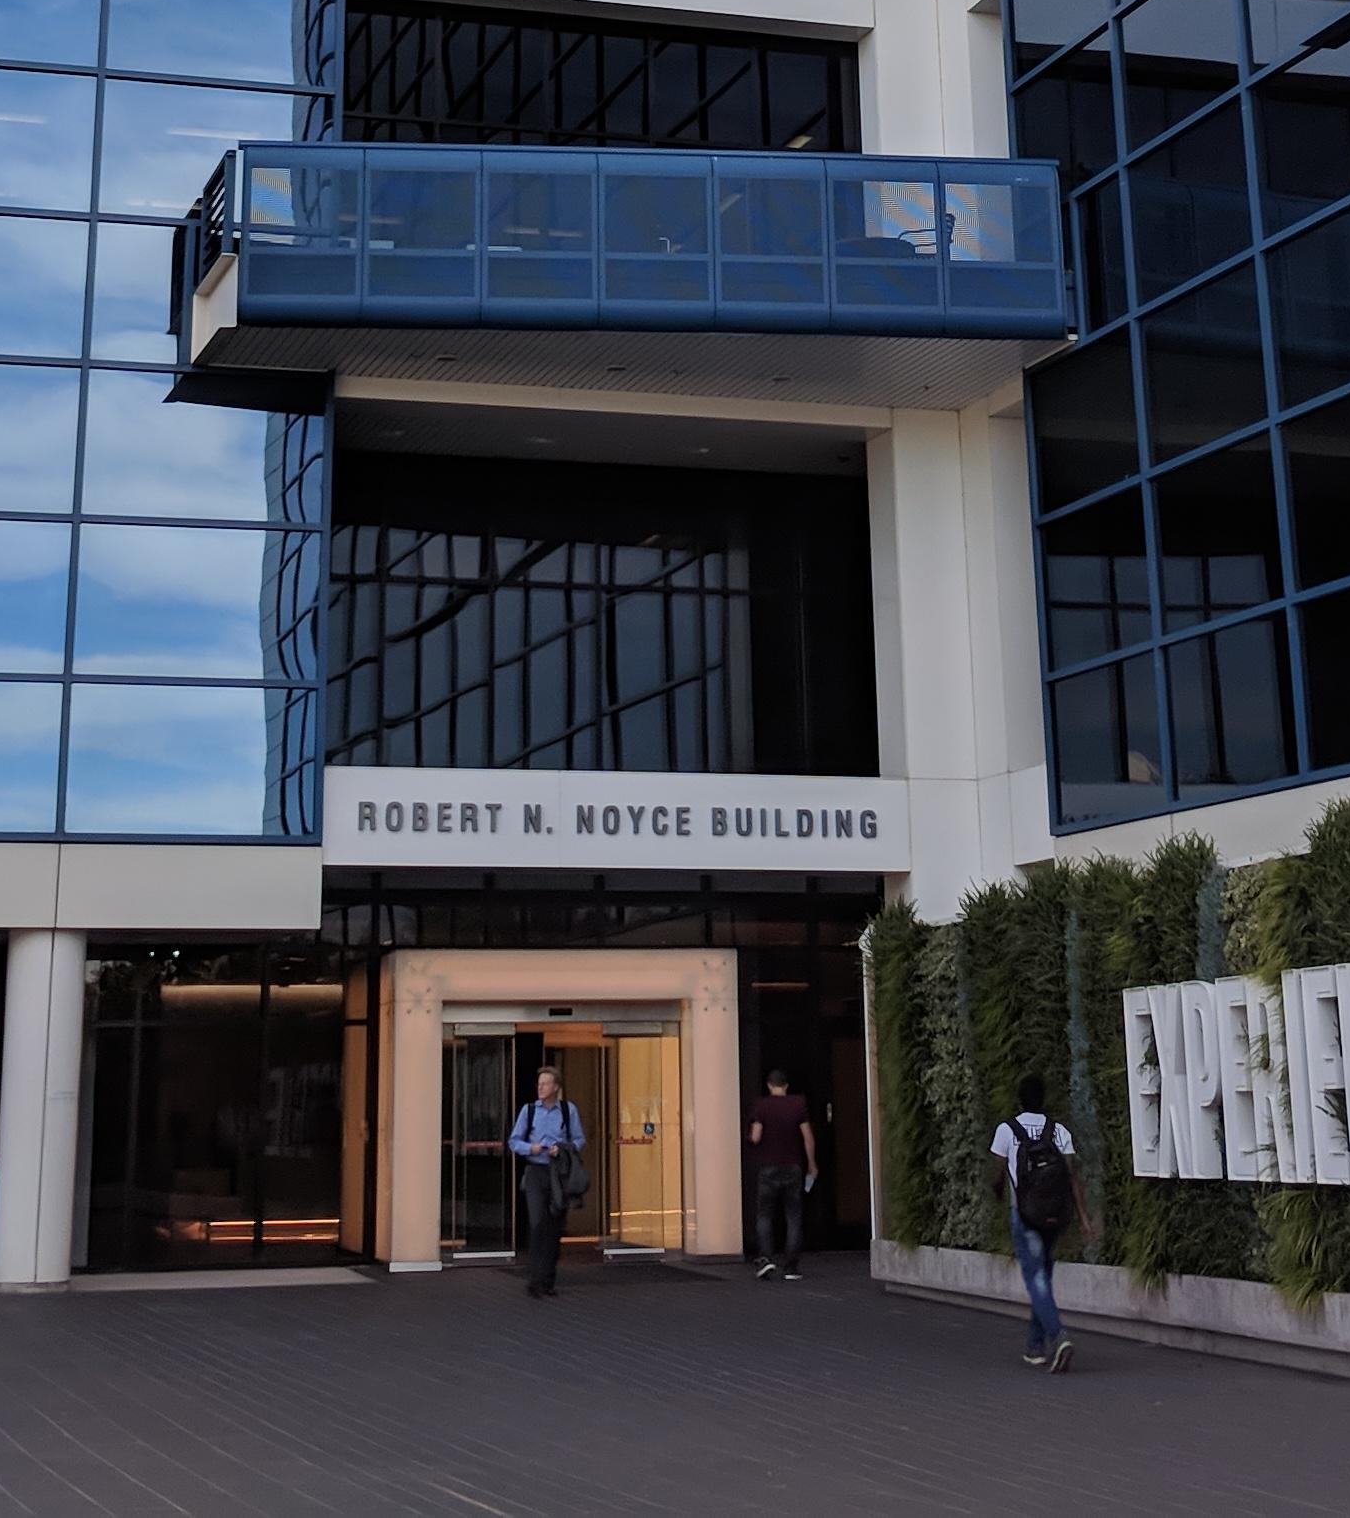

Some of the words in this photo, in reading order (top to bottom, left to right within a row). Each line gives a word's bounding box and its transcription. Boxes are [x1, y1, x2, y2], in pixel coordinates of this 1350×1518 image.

[357, 800, 504, 834] ROBERT
[523, 803, 554, 835] N.
[576, 804, 692, 837] NOYCE
[711, 807, 879, 839] BUILDING
